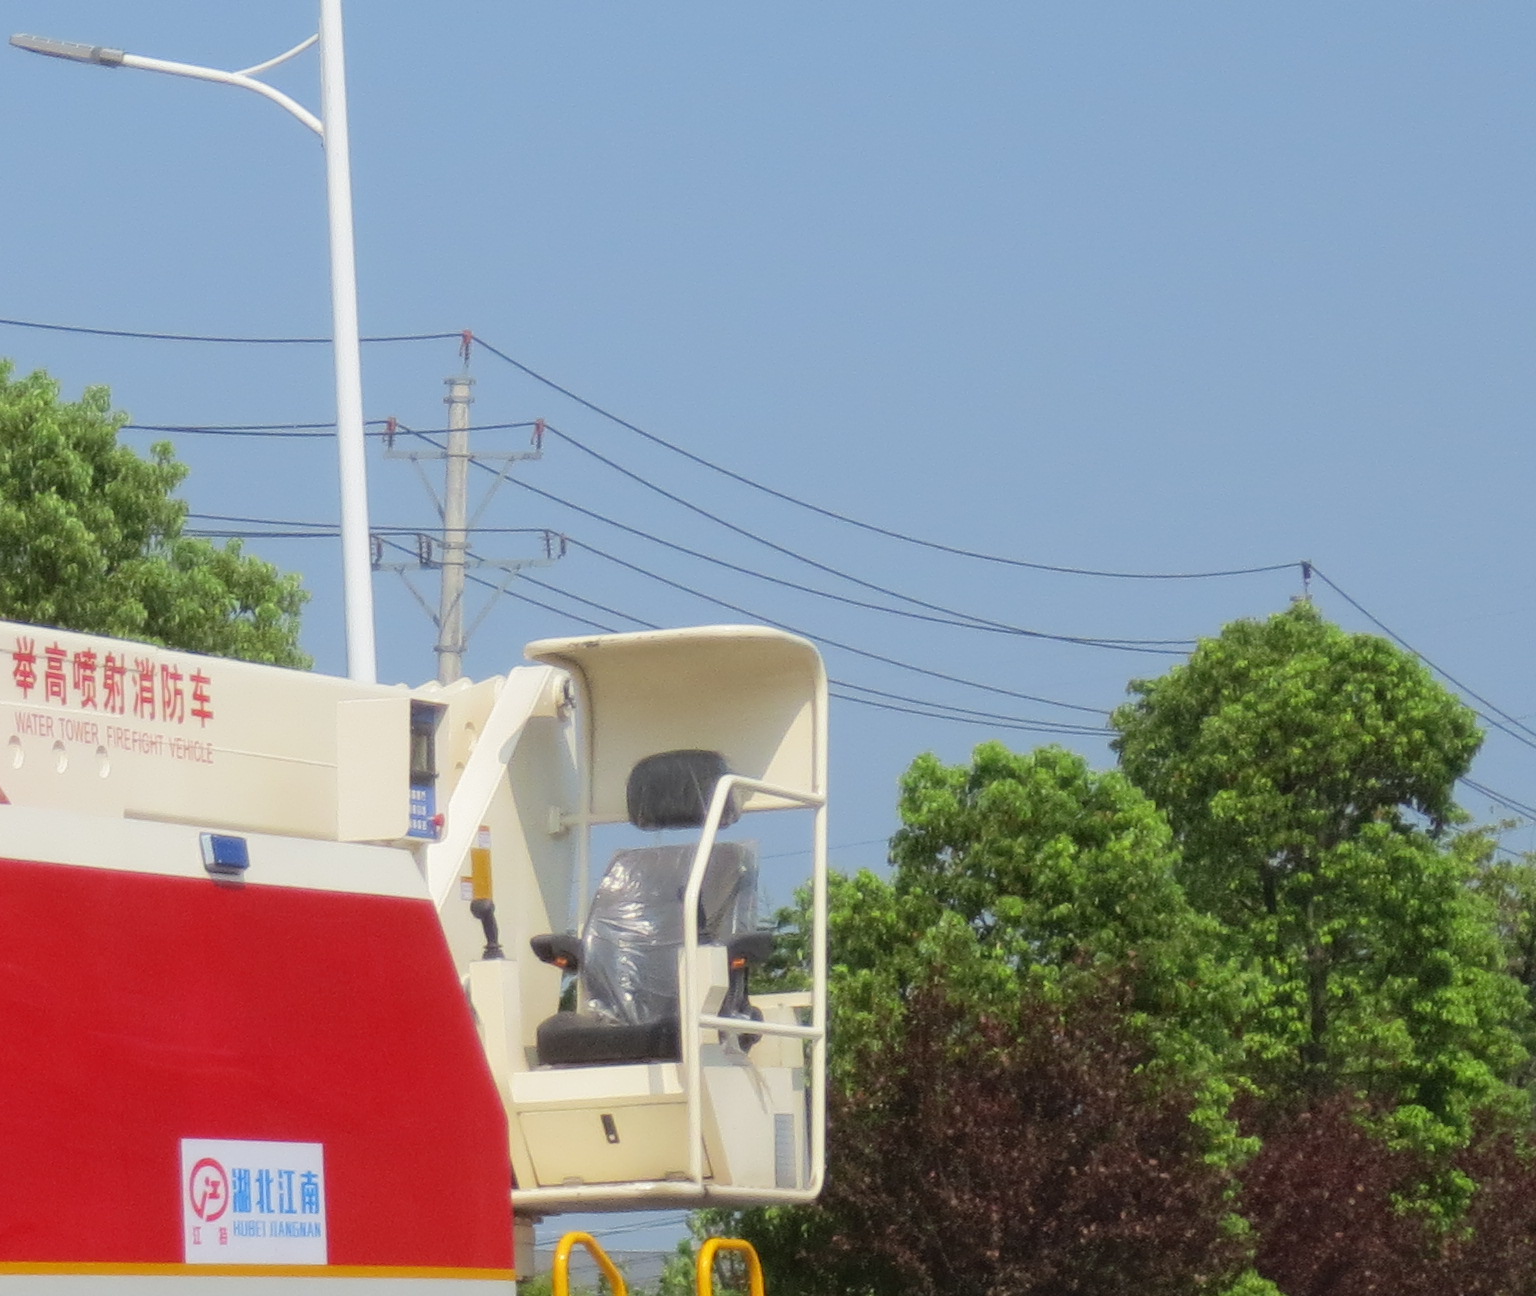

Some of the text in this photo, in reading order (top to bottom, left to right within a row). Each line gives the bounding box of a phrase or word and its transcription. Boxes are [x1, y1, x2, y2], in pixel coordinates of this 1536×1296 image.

[12, 636, 214, 728] 举高喷射消防车
[15, 712, 54, 738] WATER
[58, 717, 99, 745] TOWER
[168, 737, 214, 764] VEHICLE
[231, 1168, 320, 1215] 湖北江南
[233, 1220, 266, 1238] HUBEI
[270, 1220, 322, 1239] JIANGNAN
